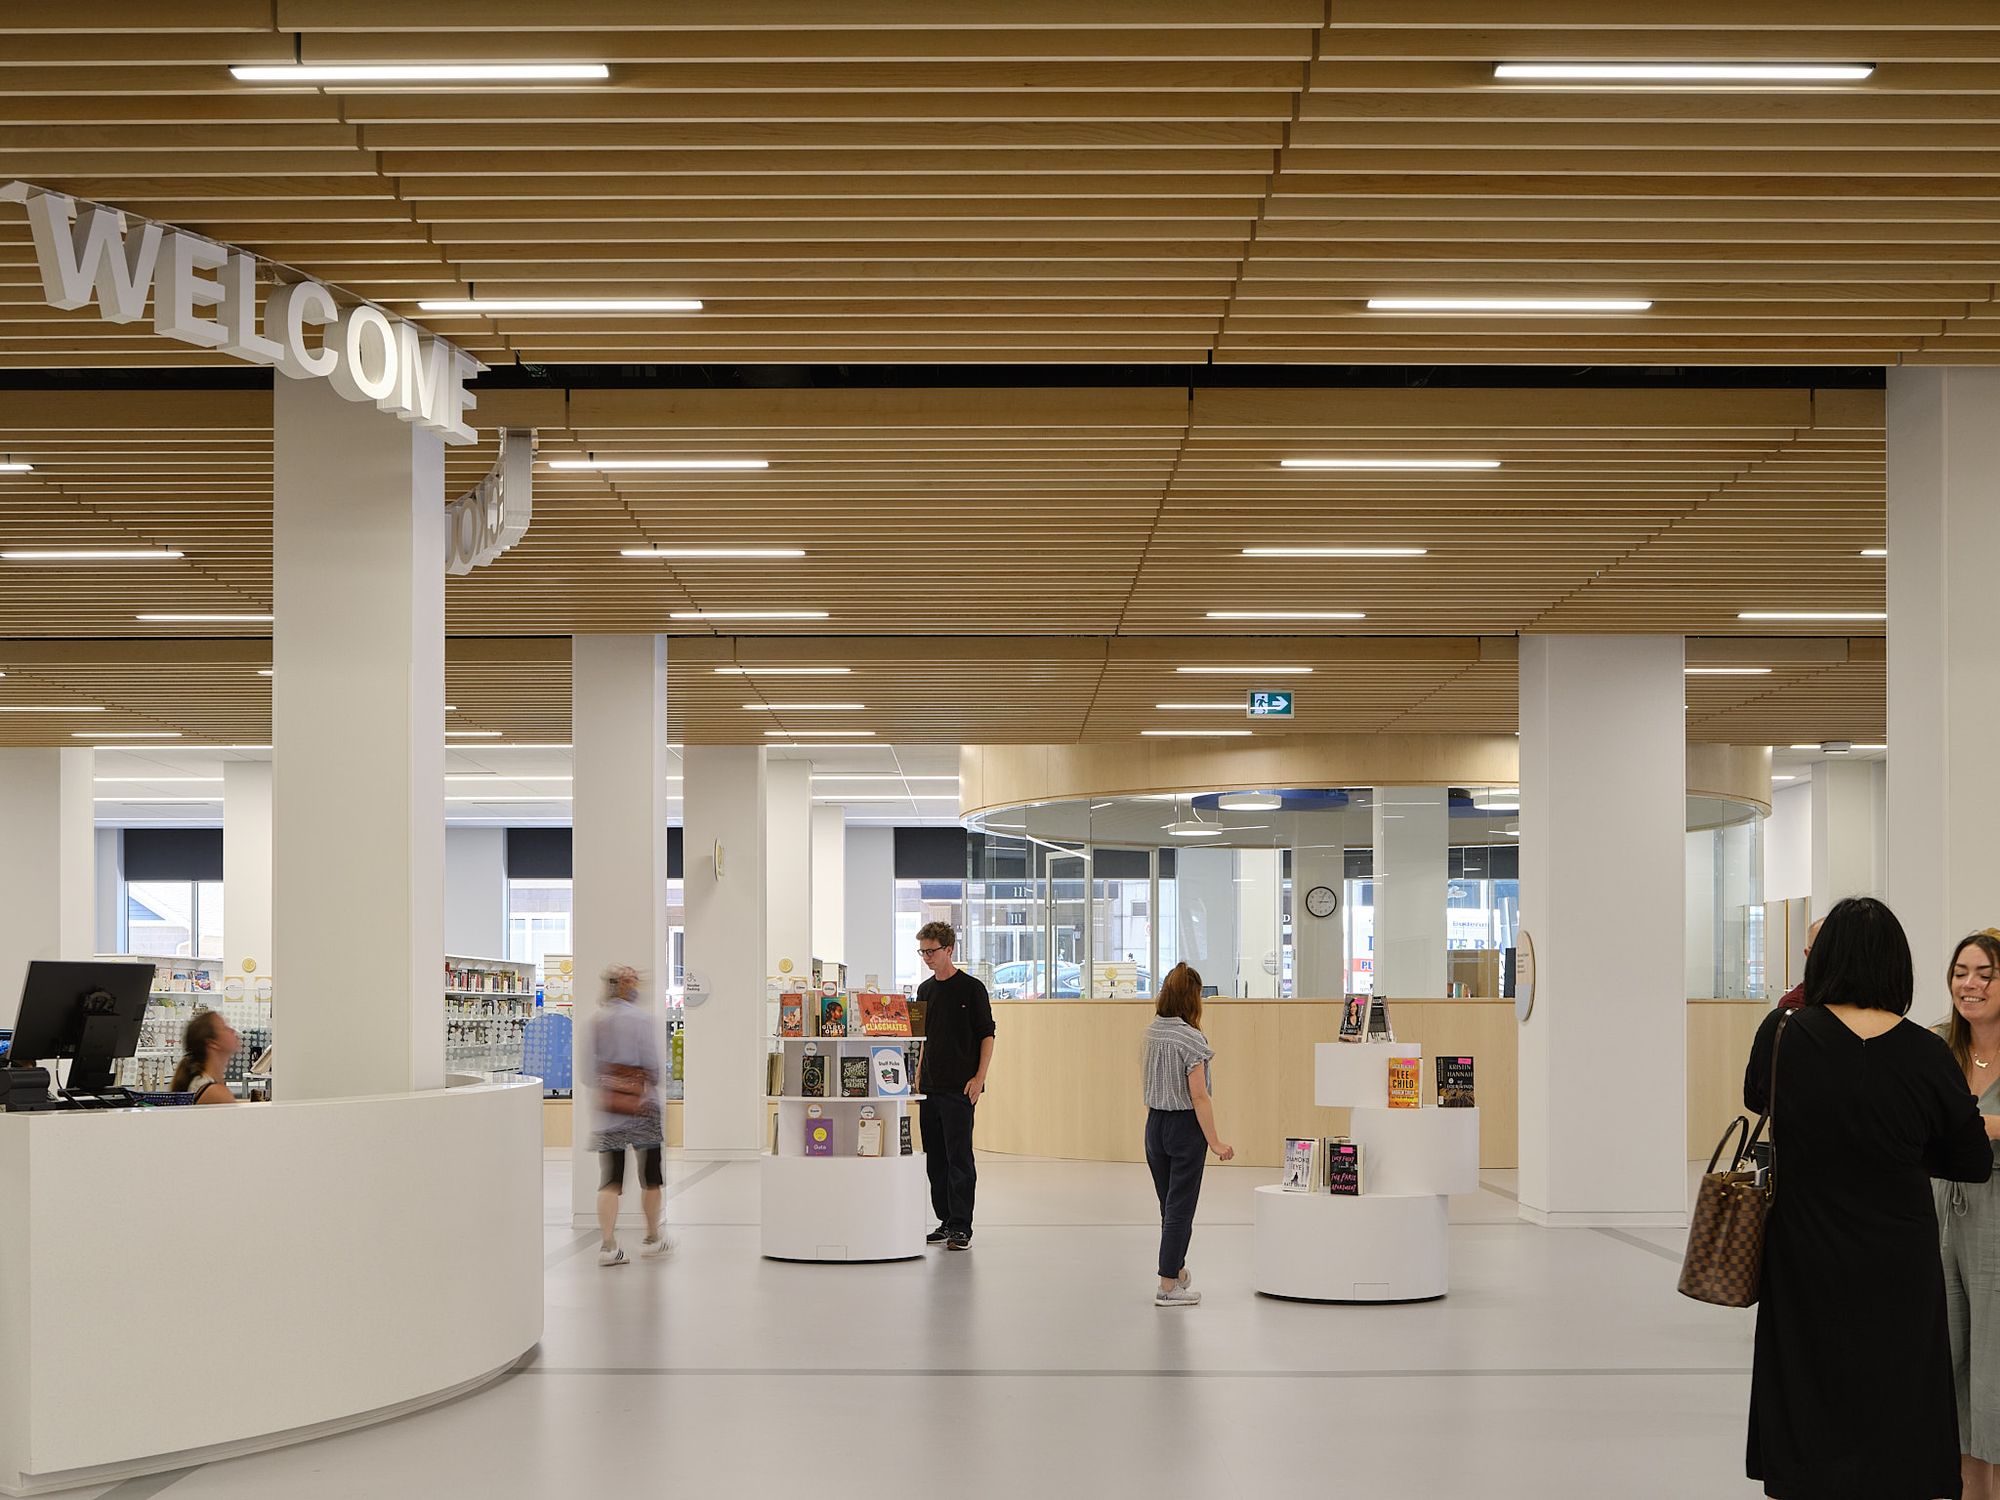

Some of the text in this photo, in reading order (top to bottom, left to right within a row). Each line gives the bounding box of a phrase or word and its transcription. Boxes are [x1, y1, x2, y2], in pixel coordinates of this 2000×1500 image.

[25, 190, 479, 446] WELCOME
[1361, 961, 1373, 970] PL
[1396, 1070, 1410, 1079] LEE
[1392, 1080, 1414, 1089] CHILD
